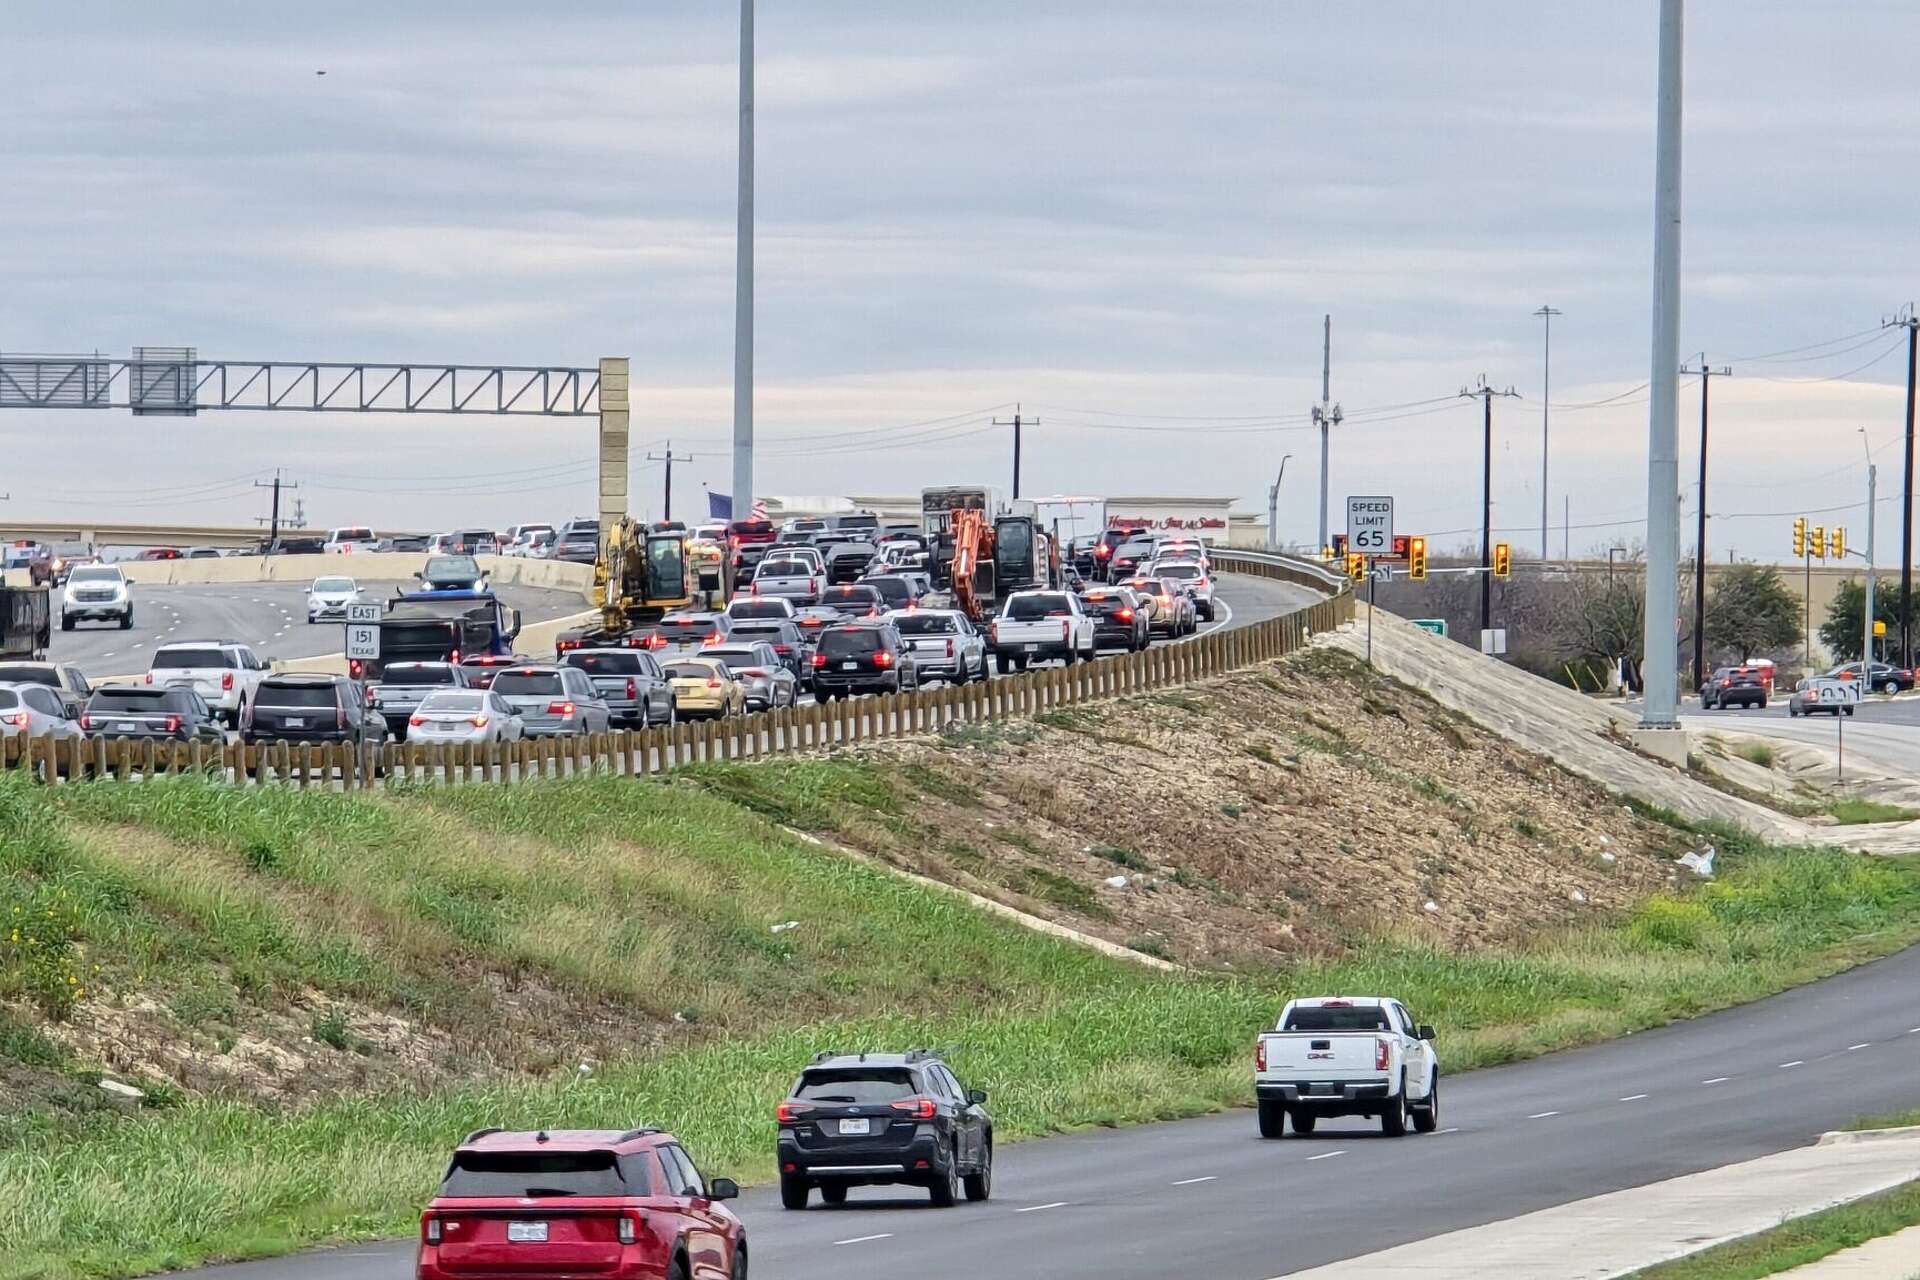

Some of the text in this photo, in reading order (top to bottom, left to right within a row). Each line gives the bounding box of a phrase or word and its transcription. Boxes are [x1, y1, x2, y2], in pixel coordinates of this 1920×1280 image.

[1351, 503, 1390, 513] SPEED
[1355, 516, 1385, 526] LIMIT
[1356, 530, 1384, 547] 65
[352, 606, 375, 619] EAST
[356, 630, 372, 643] 151
[352, 647, 375, 656] TEXAS
